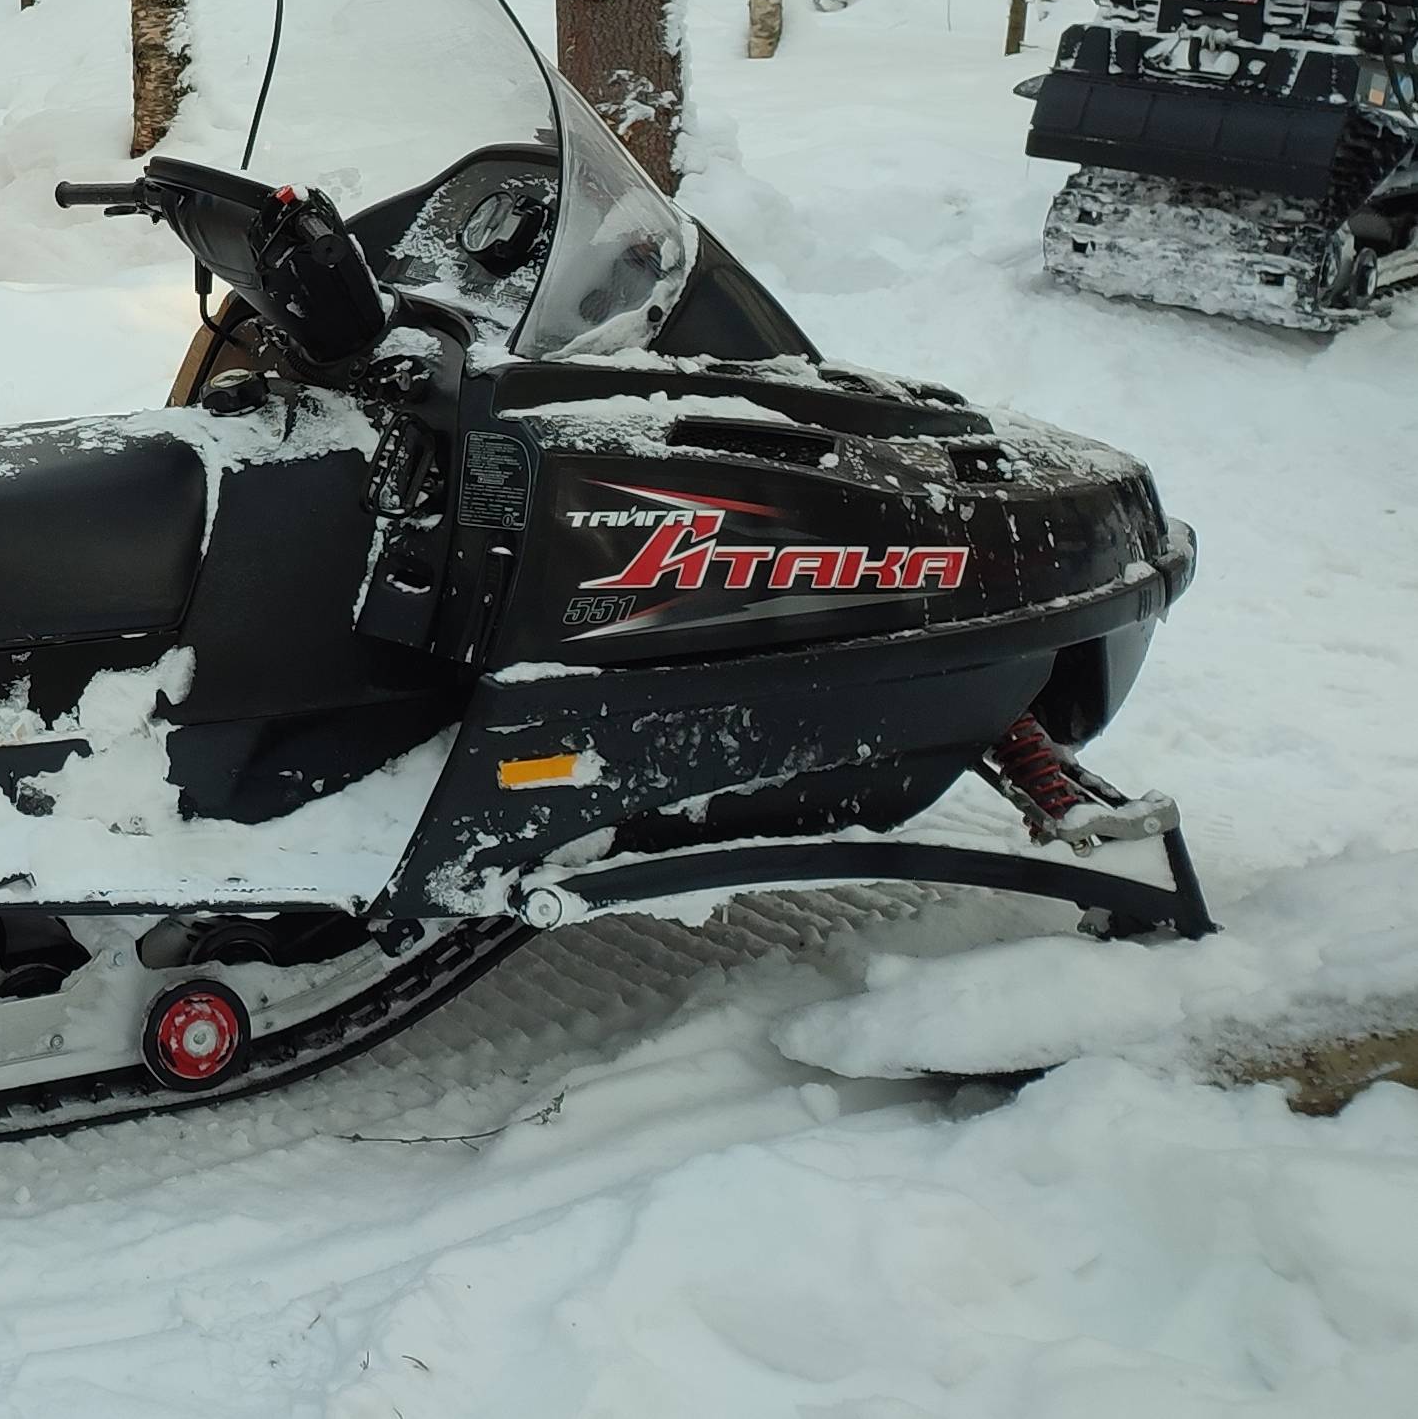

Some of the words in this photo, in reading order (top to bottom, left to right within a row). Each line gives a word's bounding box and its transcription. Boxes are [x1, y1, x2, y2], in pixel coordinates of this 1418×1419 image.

[566, 505, 695, 528] ТАЙГА
[578, 509, 970, 590] АТАКА
[562, 595, 637, 625] 551
